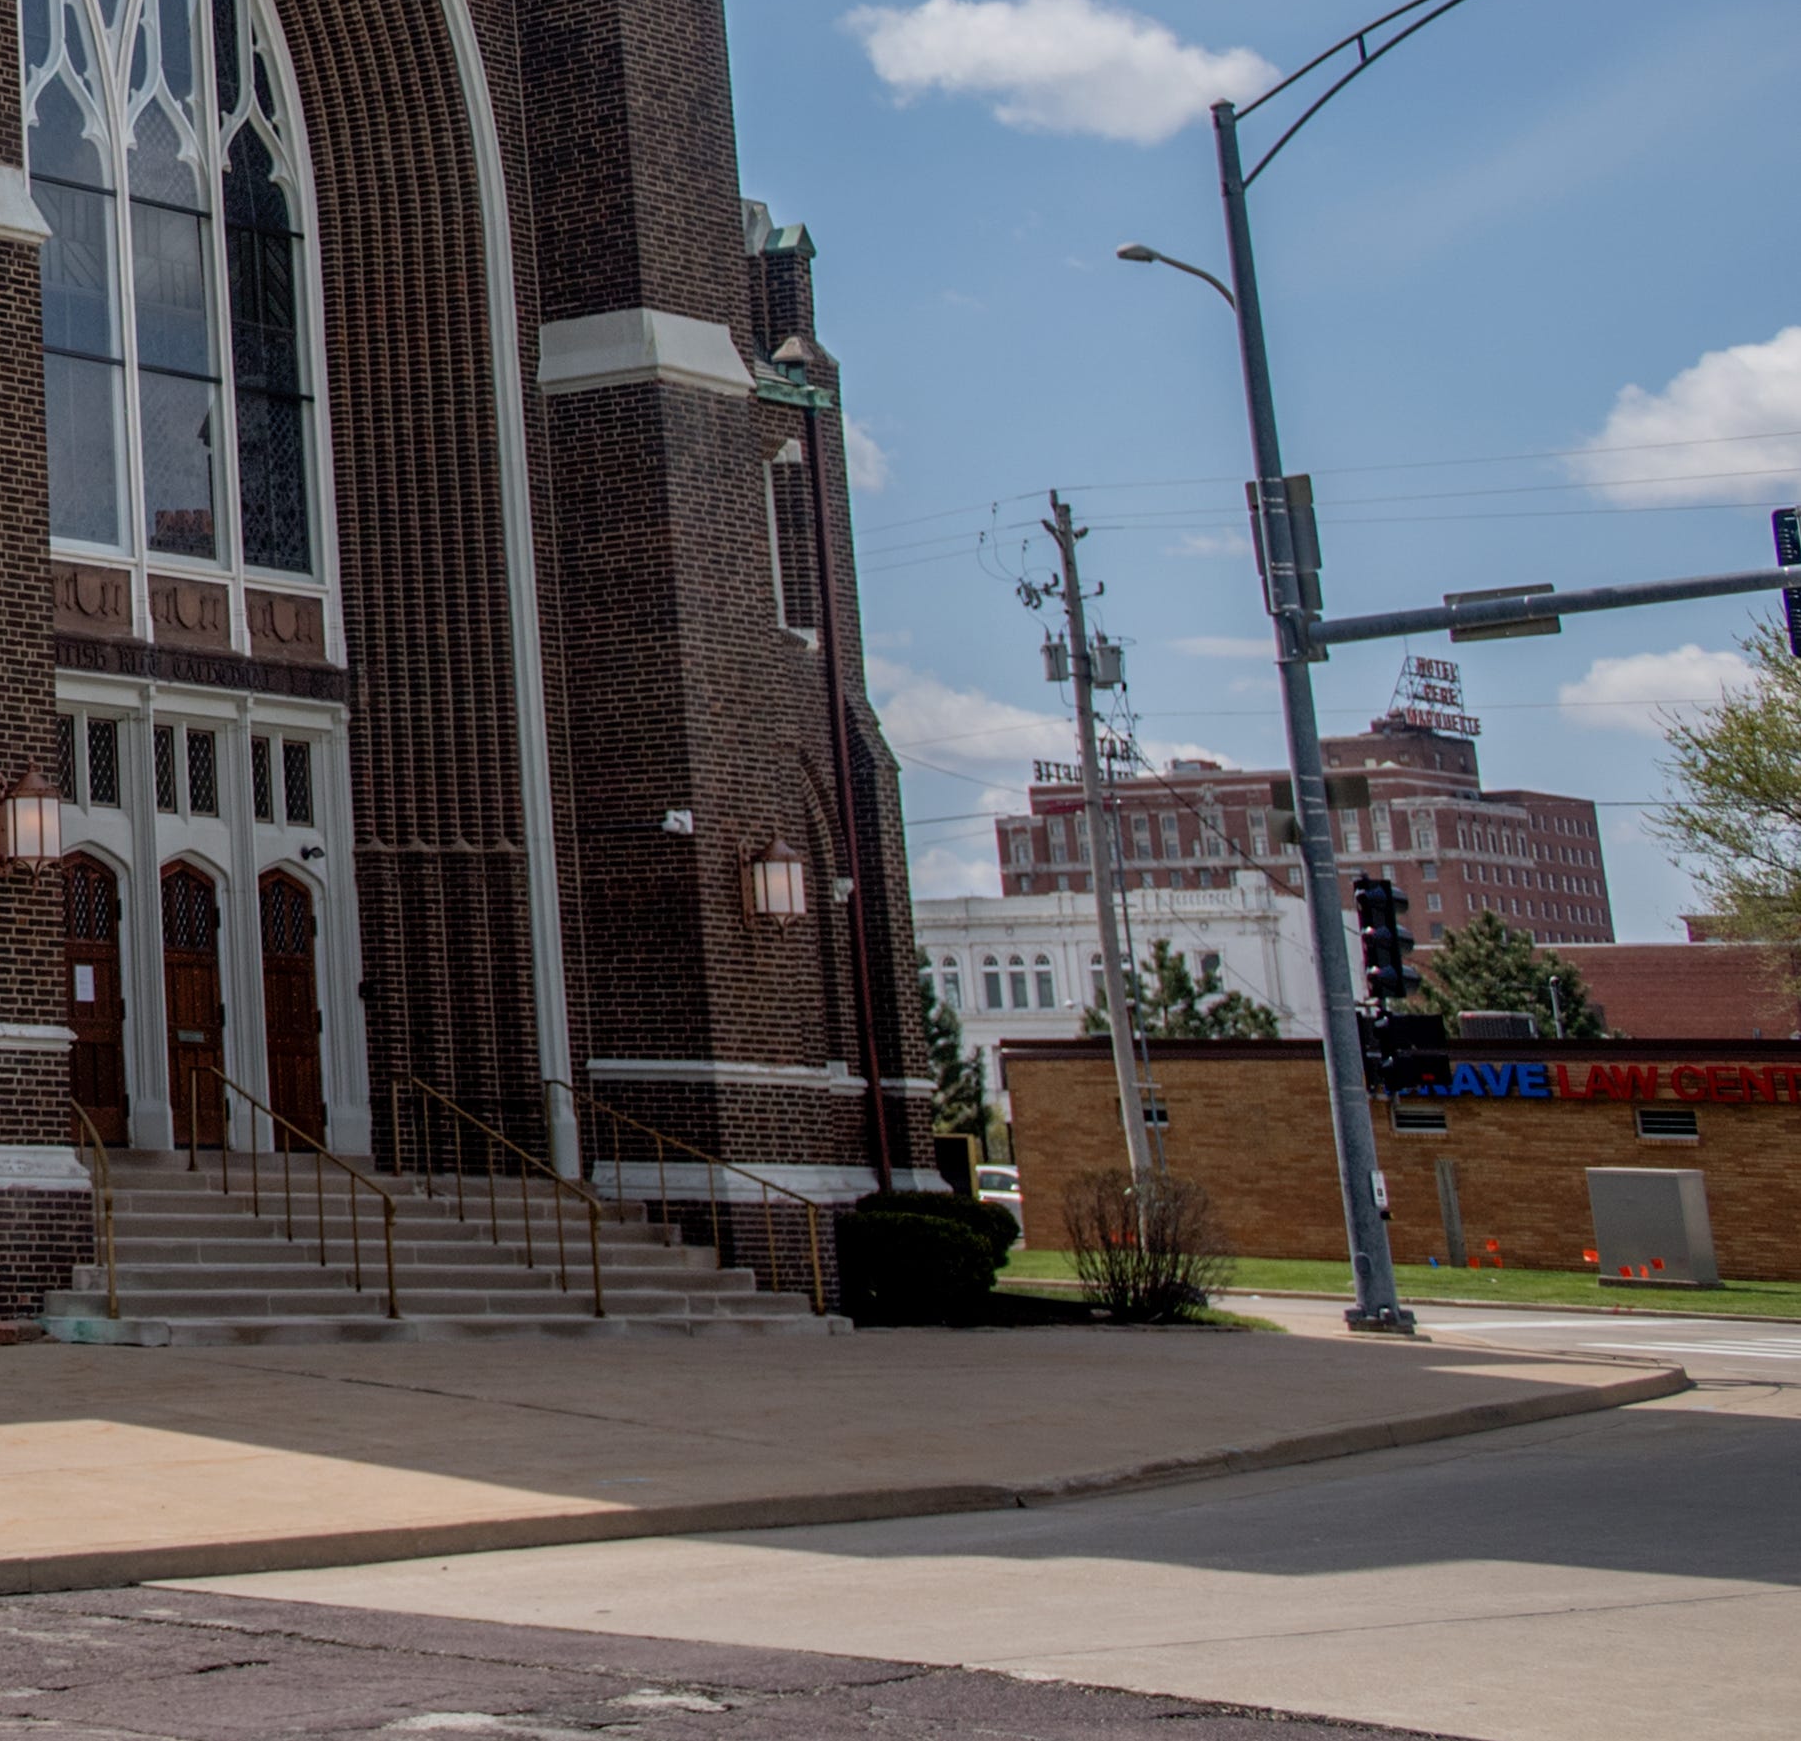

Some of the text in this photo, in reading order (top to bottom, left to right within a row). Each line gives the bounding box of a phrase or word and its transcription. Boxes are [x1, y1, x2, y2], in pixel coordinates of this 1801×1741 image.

[1416, 657, 1457, 681] HOTEL
[1424, 684, 1458, 706] PERE
[1406, 706, 1481, 736] MARQUETTE
[1385, 1062, 1801, 1103] AVE LAW CENT
